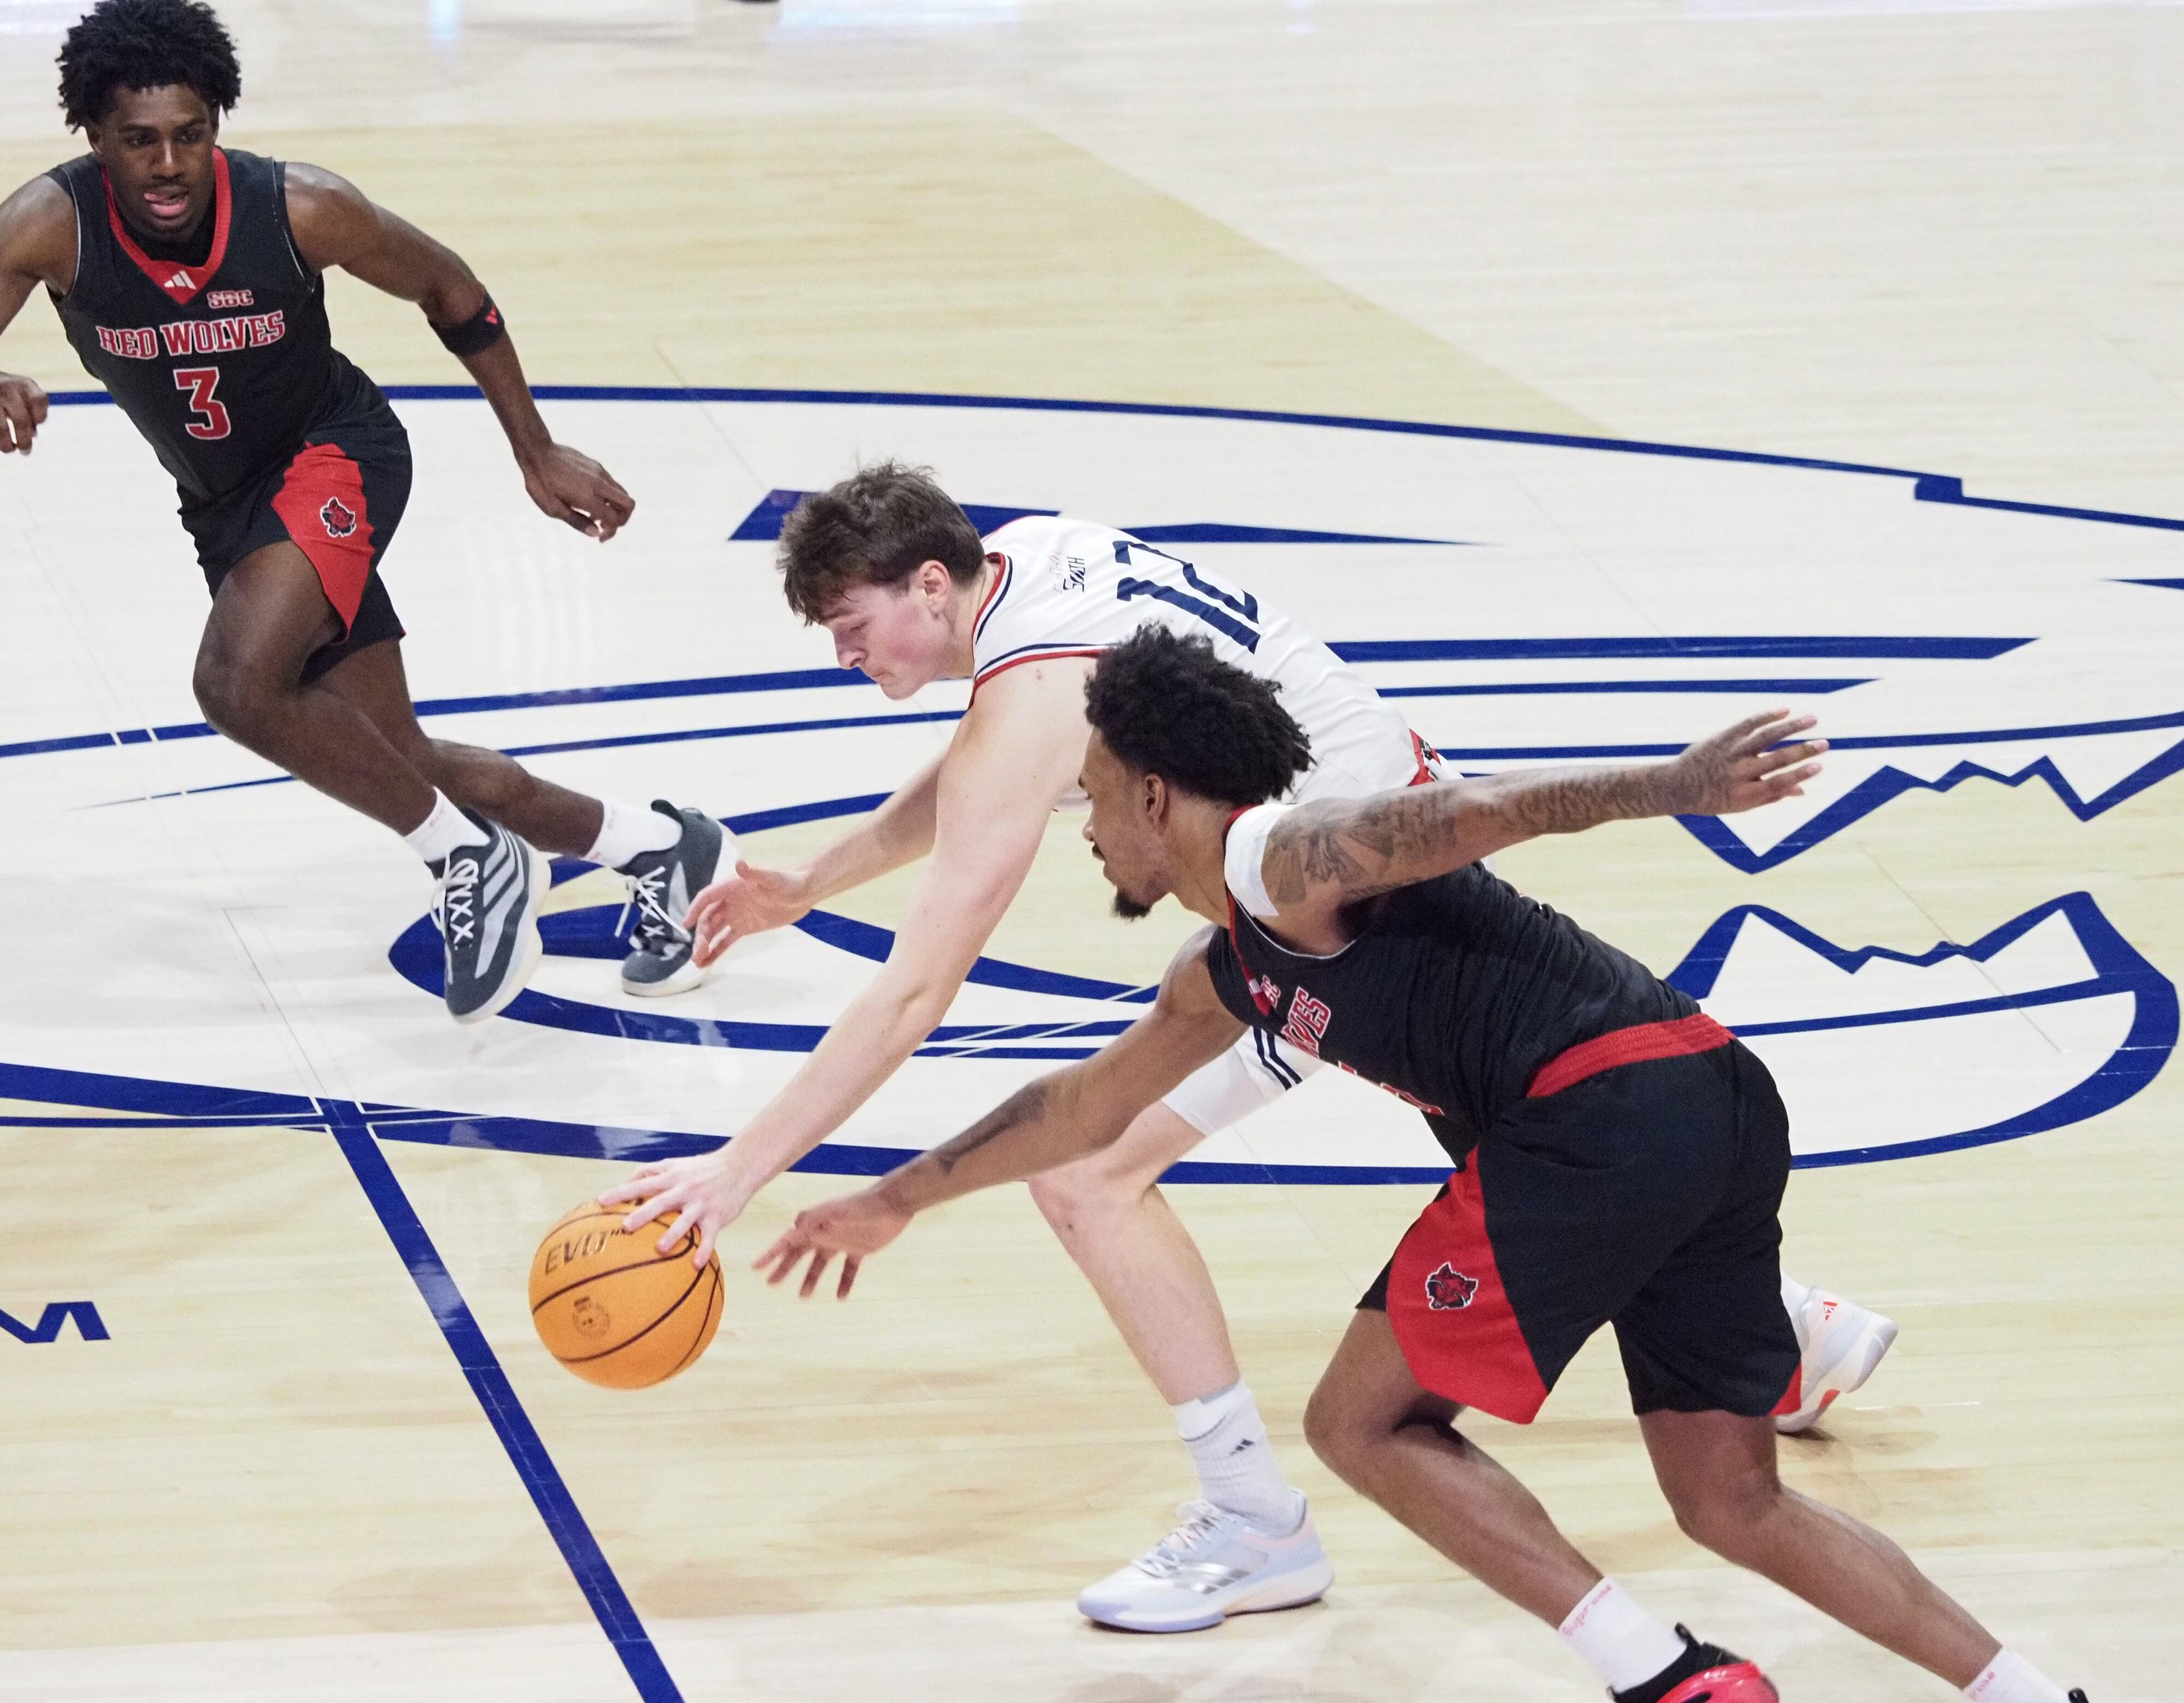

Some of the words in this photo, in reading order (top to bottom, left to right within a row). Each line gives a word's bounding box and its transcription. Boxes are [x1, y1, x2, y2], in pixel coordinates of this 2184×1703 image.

[207, 289, 254, 309] SBC
[95, 326, 159, 360] RED
[160, 310, 285, 356] WOLVES
[173, 367, 231, 440] 3
[1113, 541, 1260, 655] 12
